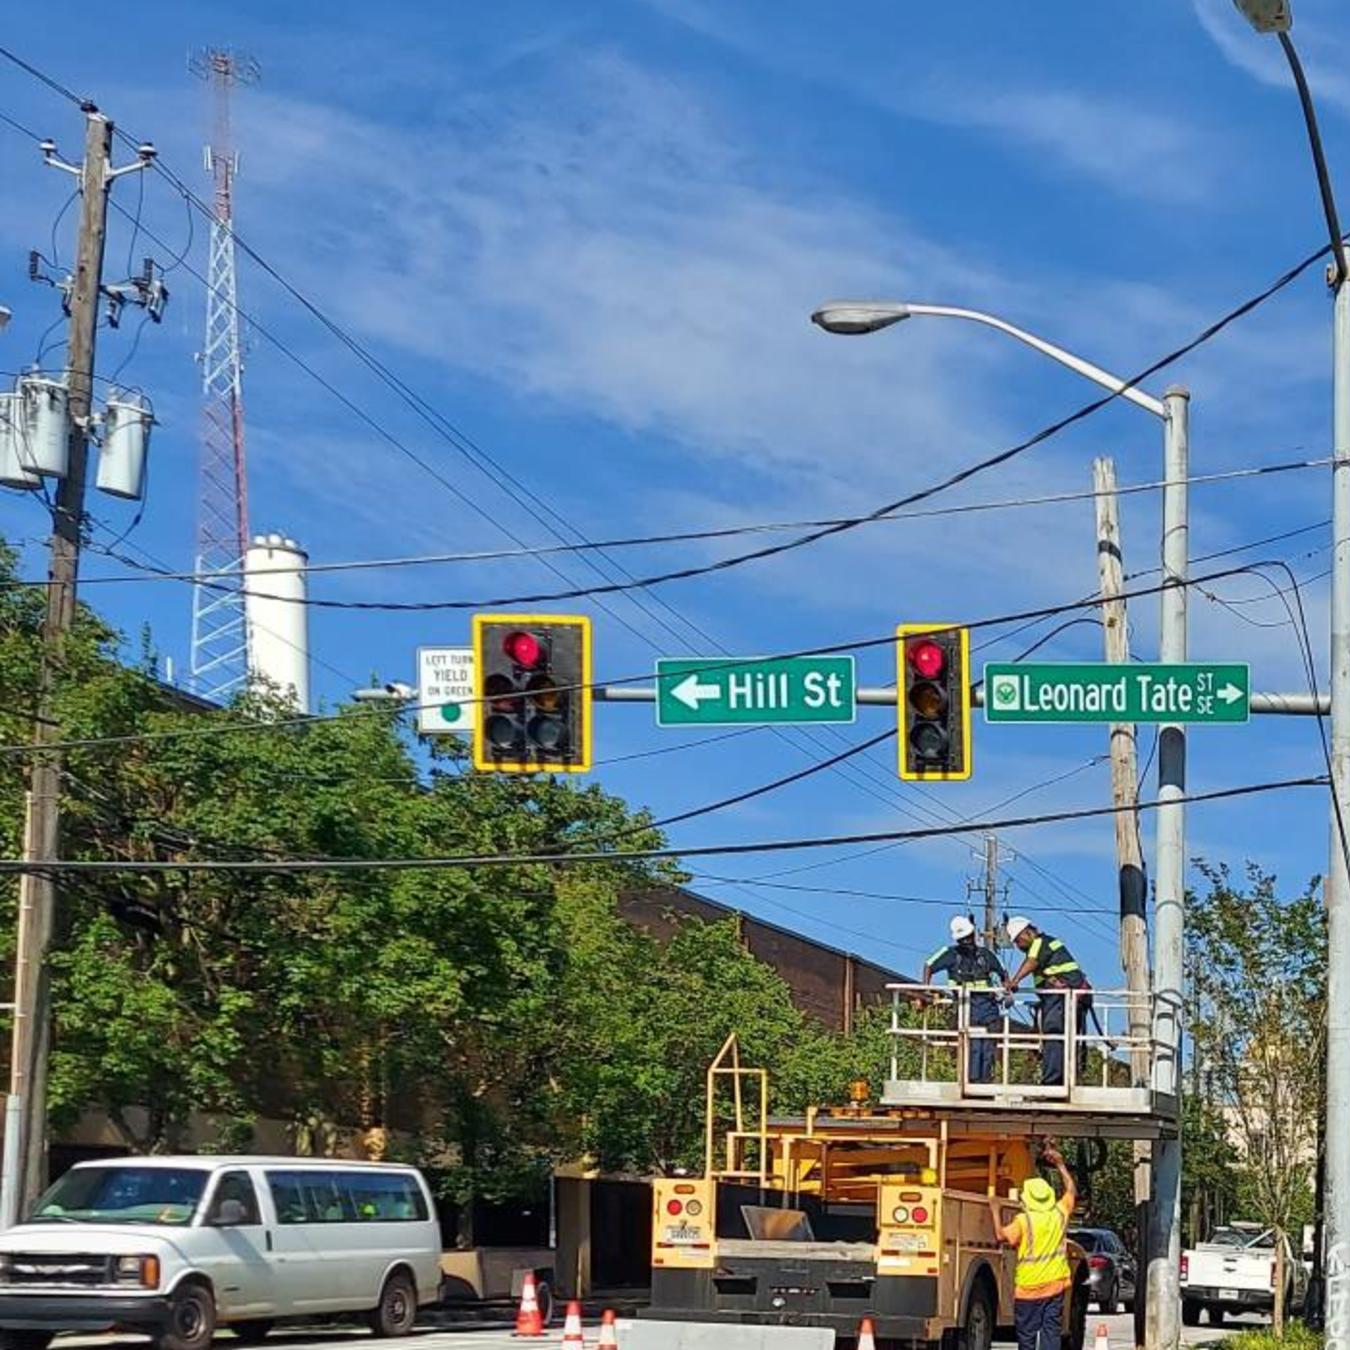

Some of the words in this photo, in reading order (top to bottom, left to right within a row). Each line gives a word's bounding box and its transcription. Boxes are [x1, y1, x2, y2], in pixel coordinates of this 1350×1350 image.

[426, 655, 447, 666] LEFT
[451, 655, 474, 665] TURN
[434, 669, 467, 682] YIELD
[1196, 673, 1215, 691] ST
[428, 686, 441, 697] ON
[444, 686, 474, 697] GREEN
[728, 672, 788, 709] Hill
[803, 671, 842, 708] St
[1023, 674, 1127, 712] Leonard
[1136, 675, 1193, 712] Tate
[1196, 695, 1215, 714] SE
